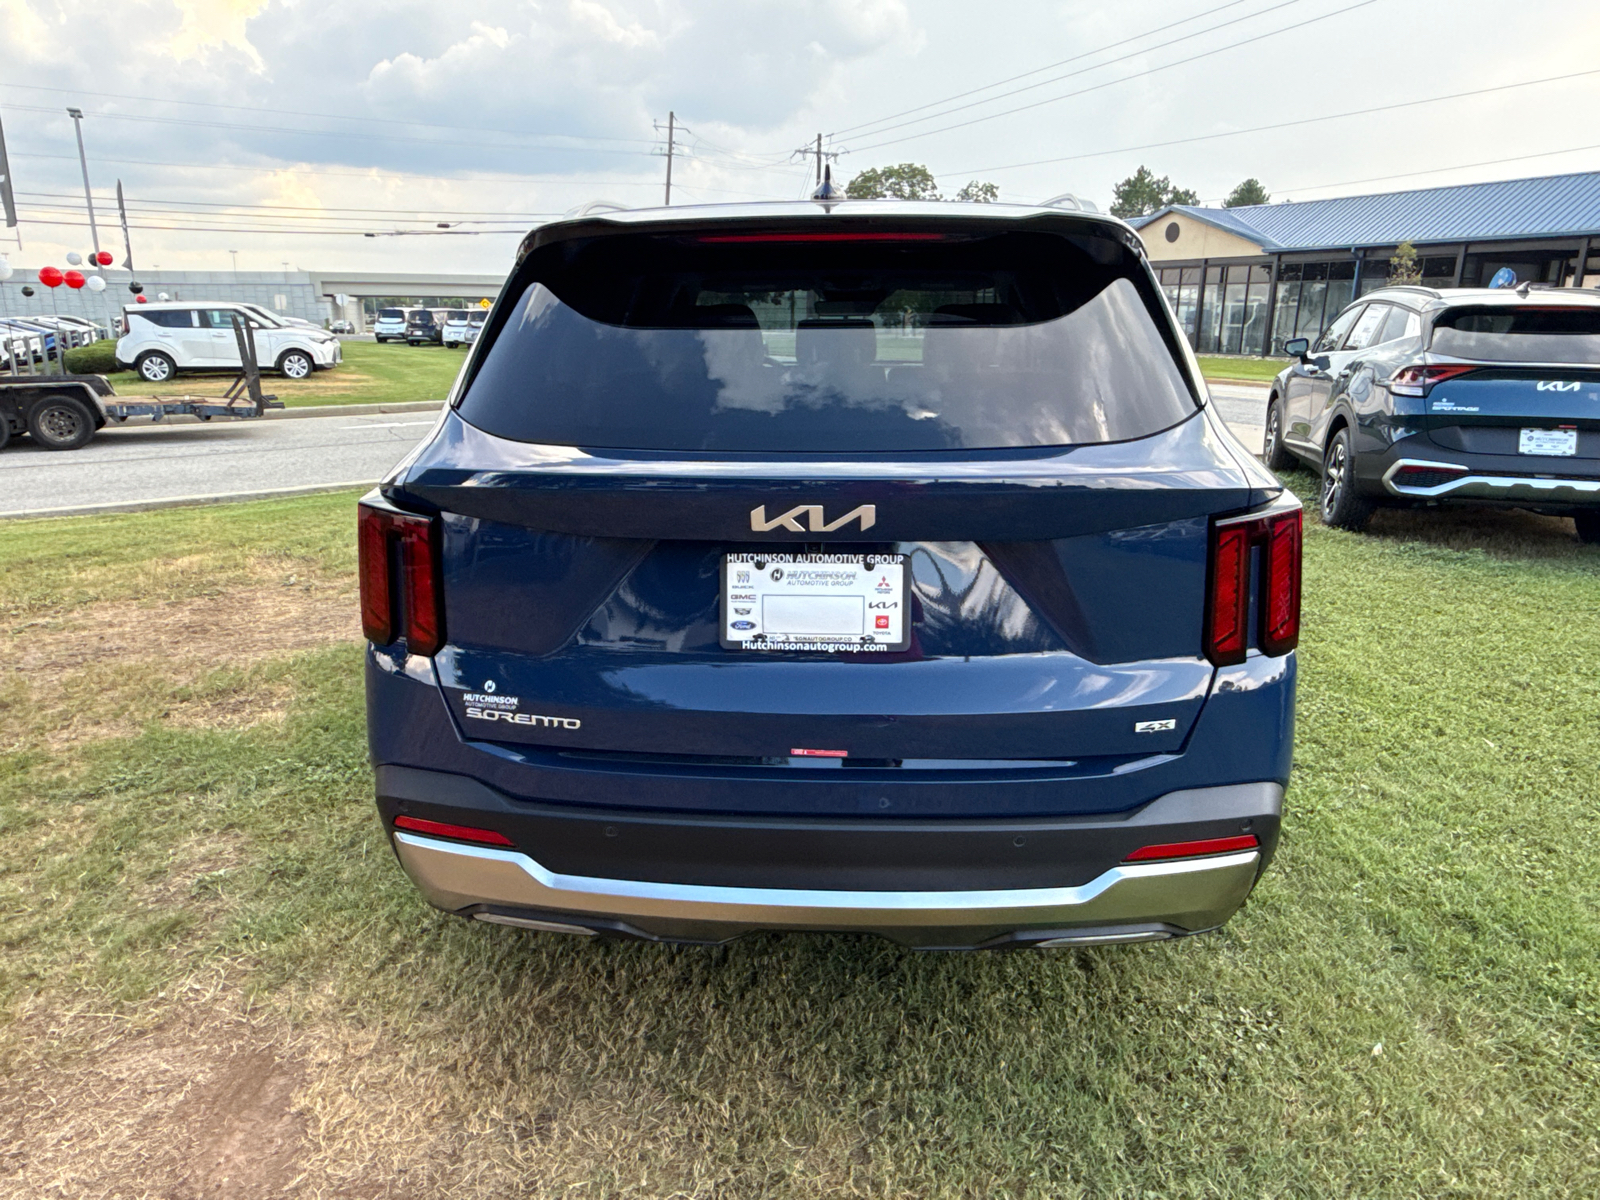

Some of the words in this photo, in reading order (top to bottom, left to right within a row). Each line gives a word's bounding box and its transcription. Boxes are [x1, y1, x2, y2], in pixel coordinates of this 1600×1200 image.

[1537, 381, 1580, 391] KIA
[751, 504, 876, 532] KIA
[727, 553, 793, 563] HUTCHINSON
[796, 553, 864, 564] AUTOMOTIVE
[867, 554, 904, 564] GROUP
[786, 570, 857, 580] HUTCHINSON
[868, 601, 898, 609] KIA
[742, 641, 887, 653] Hutchinsonautogroup.com
[463, 693, 518, 705] HUTCHINSON
[466, 707, 581, 730] SORENTO
